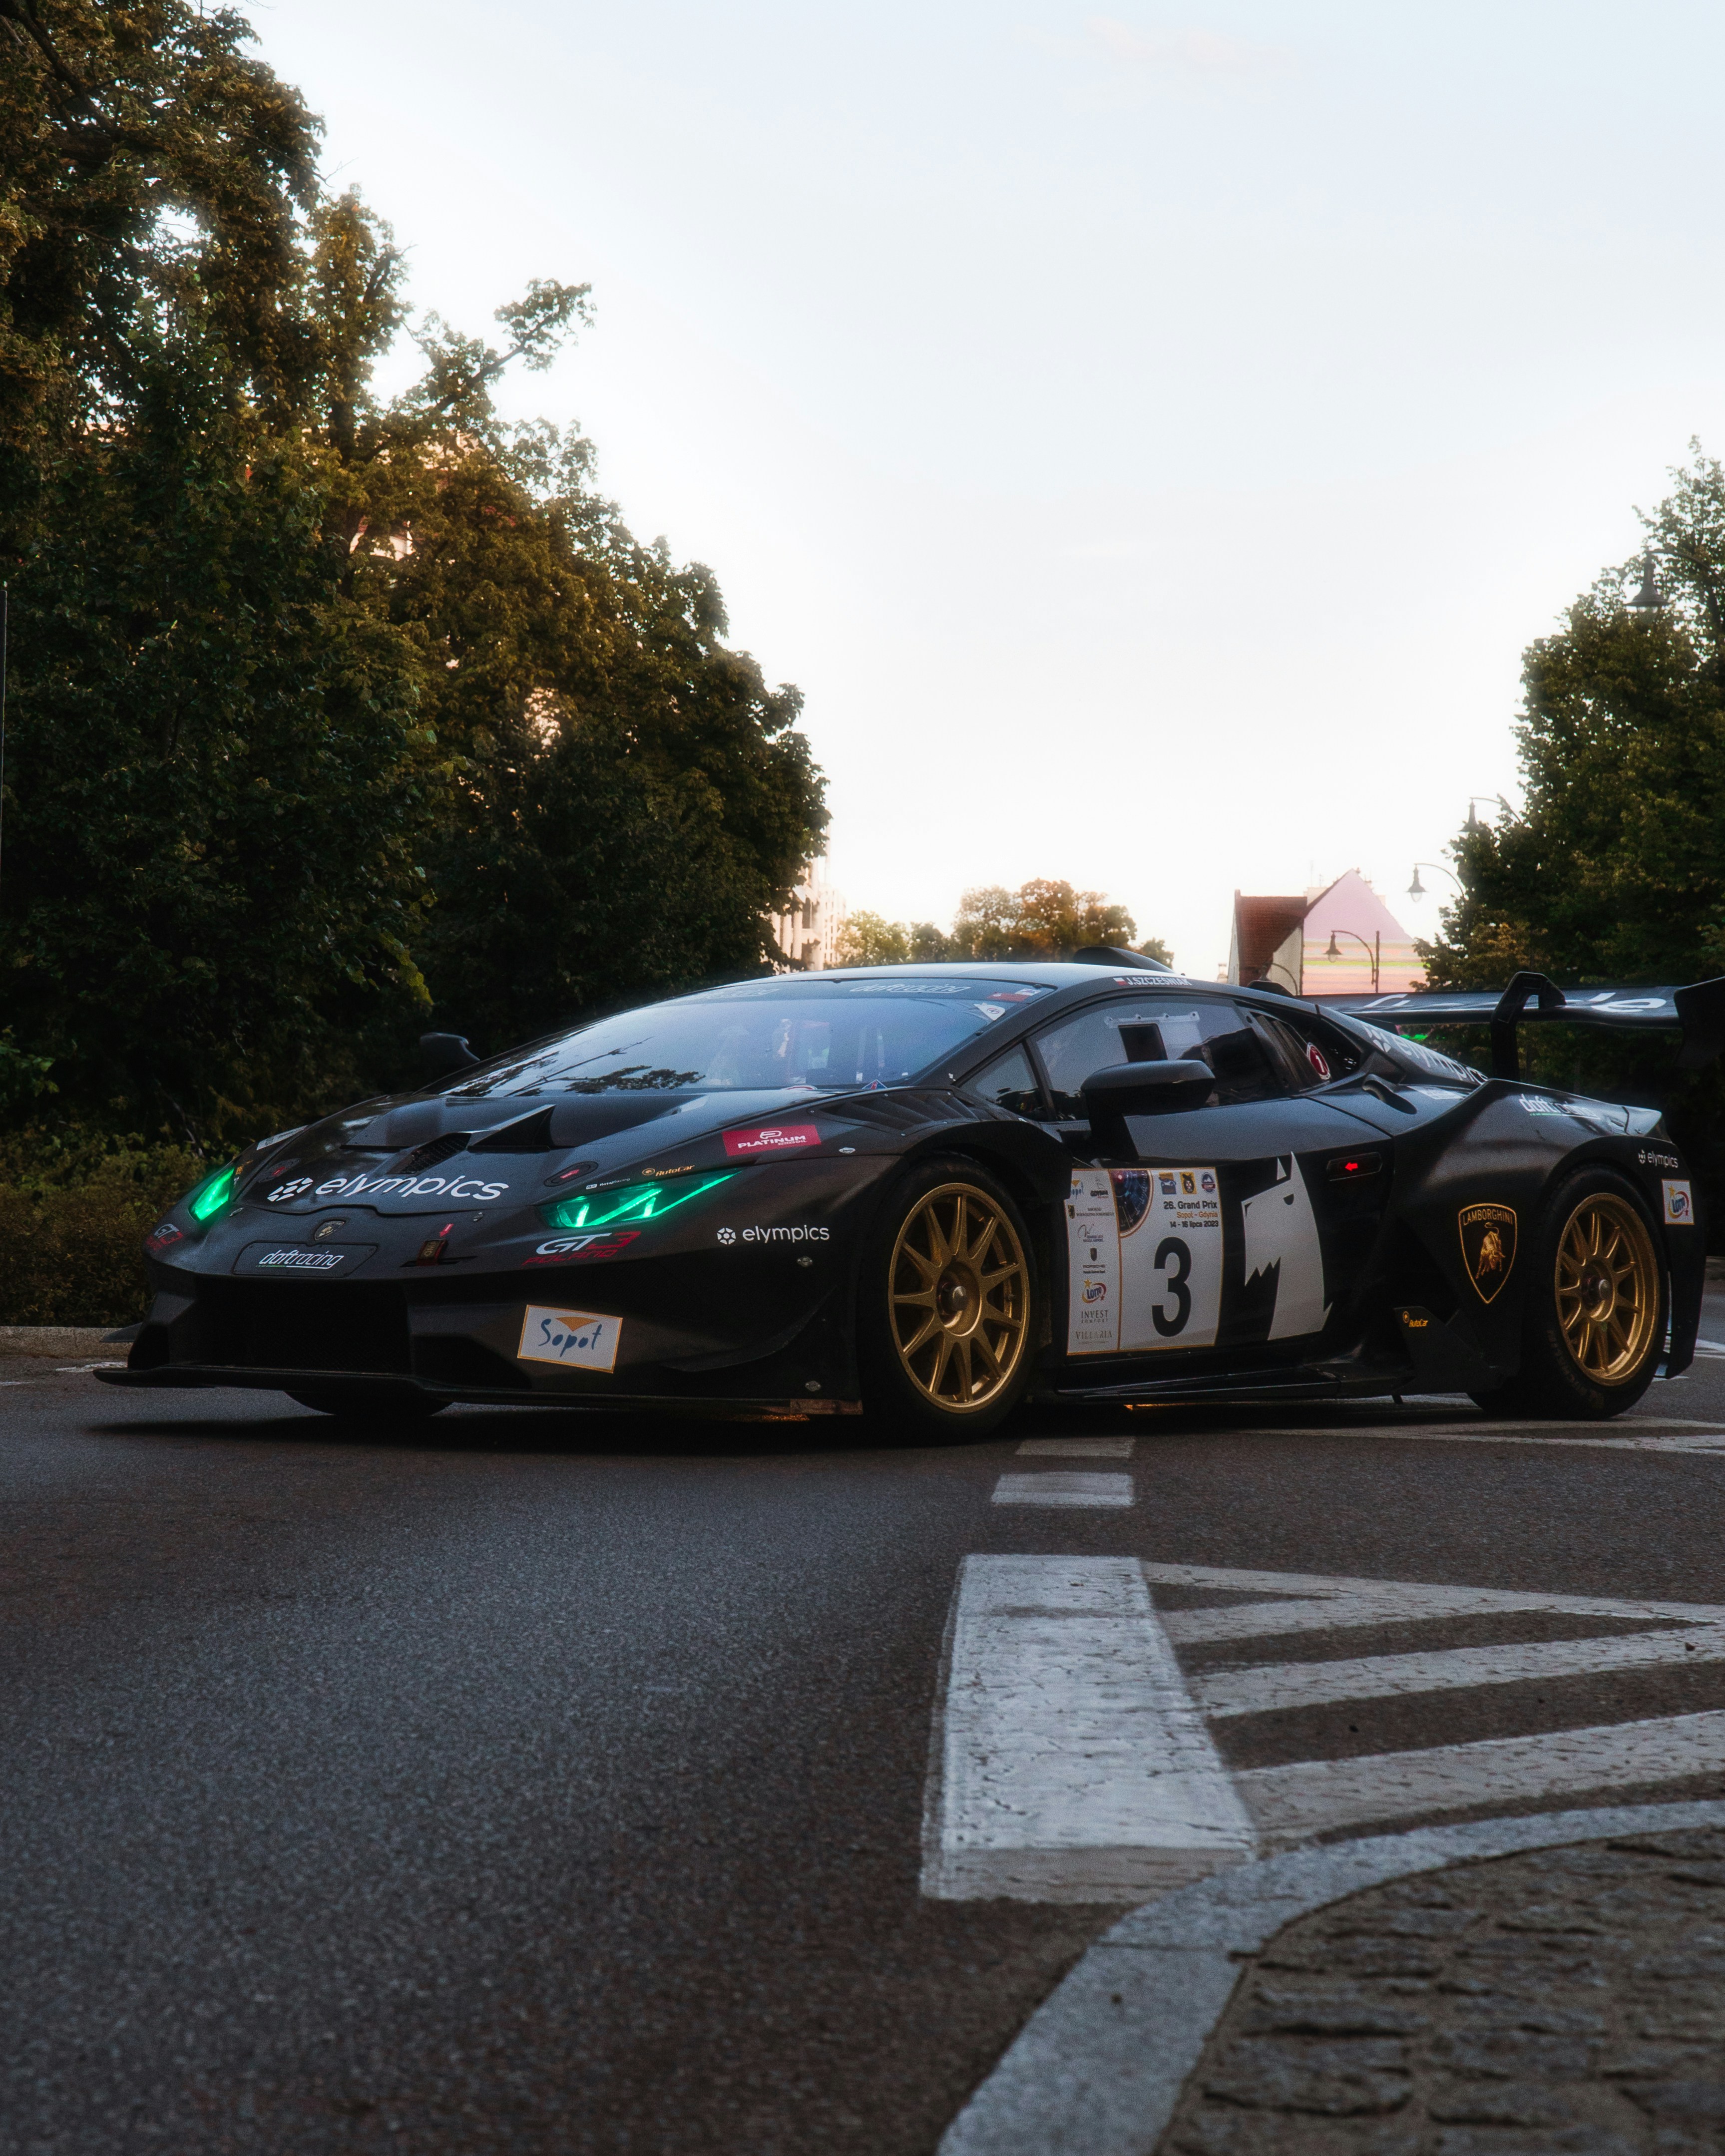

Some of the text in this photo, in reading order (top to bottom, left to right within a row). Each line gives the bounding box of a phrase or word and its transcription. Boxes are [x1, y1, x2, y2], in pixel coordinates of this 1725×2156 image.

[1126, 977, 1193, 986] J.SZCZEŚNIAK
[737, 1135, 806, 1149] PLATINUM
[1647, 1151, 1679, 1168] elympics
[315, 1173, 509, 1200] elympics
[1163, 1200, 1218, 1209] 26. Grand Prix
[1463, 1208, 1513, 1226] LAMBORGHINI
[536, 1231, 641, 1254] GT3
[742, 1224, 830, 1244] elympics
[258, 1249, 345, 1269] daftracing
[1152, 1236, 1192, 1338] 3
[1081, 1310, 1109, 1319] INVEST
[538, 1318, 602, 1358] Sopot
